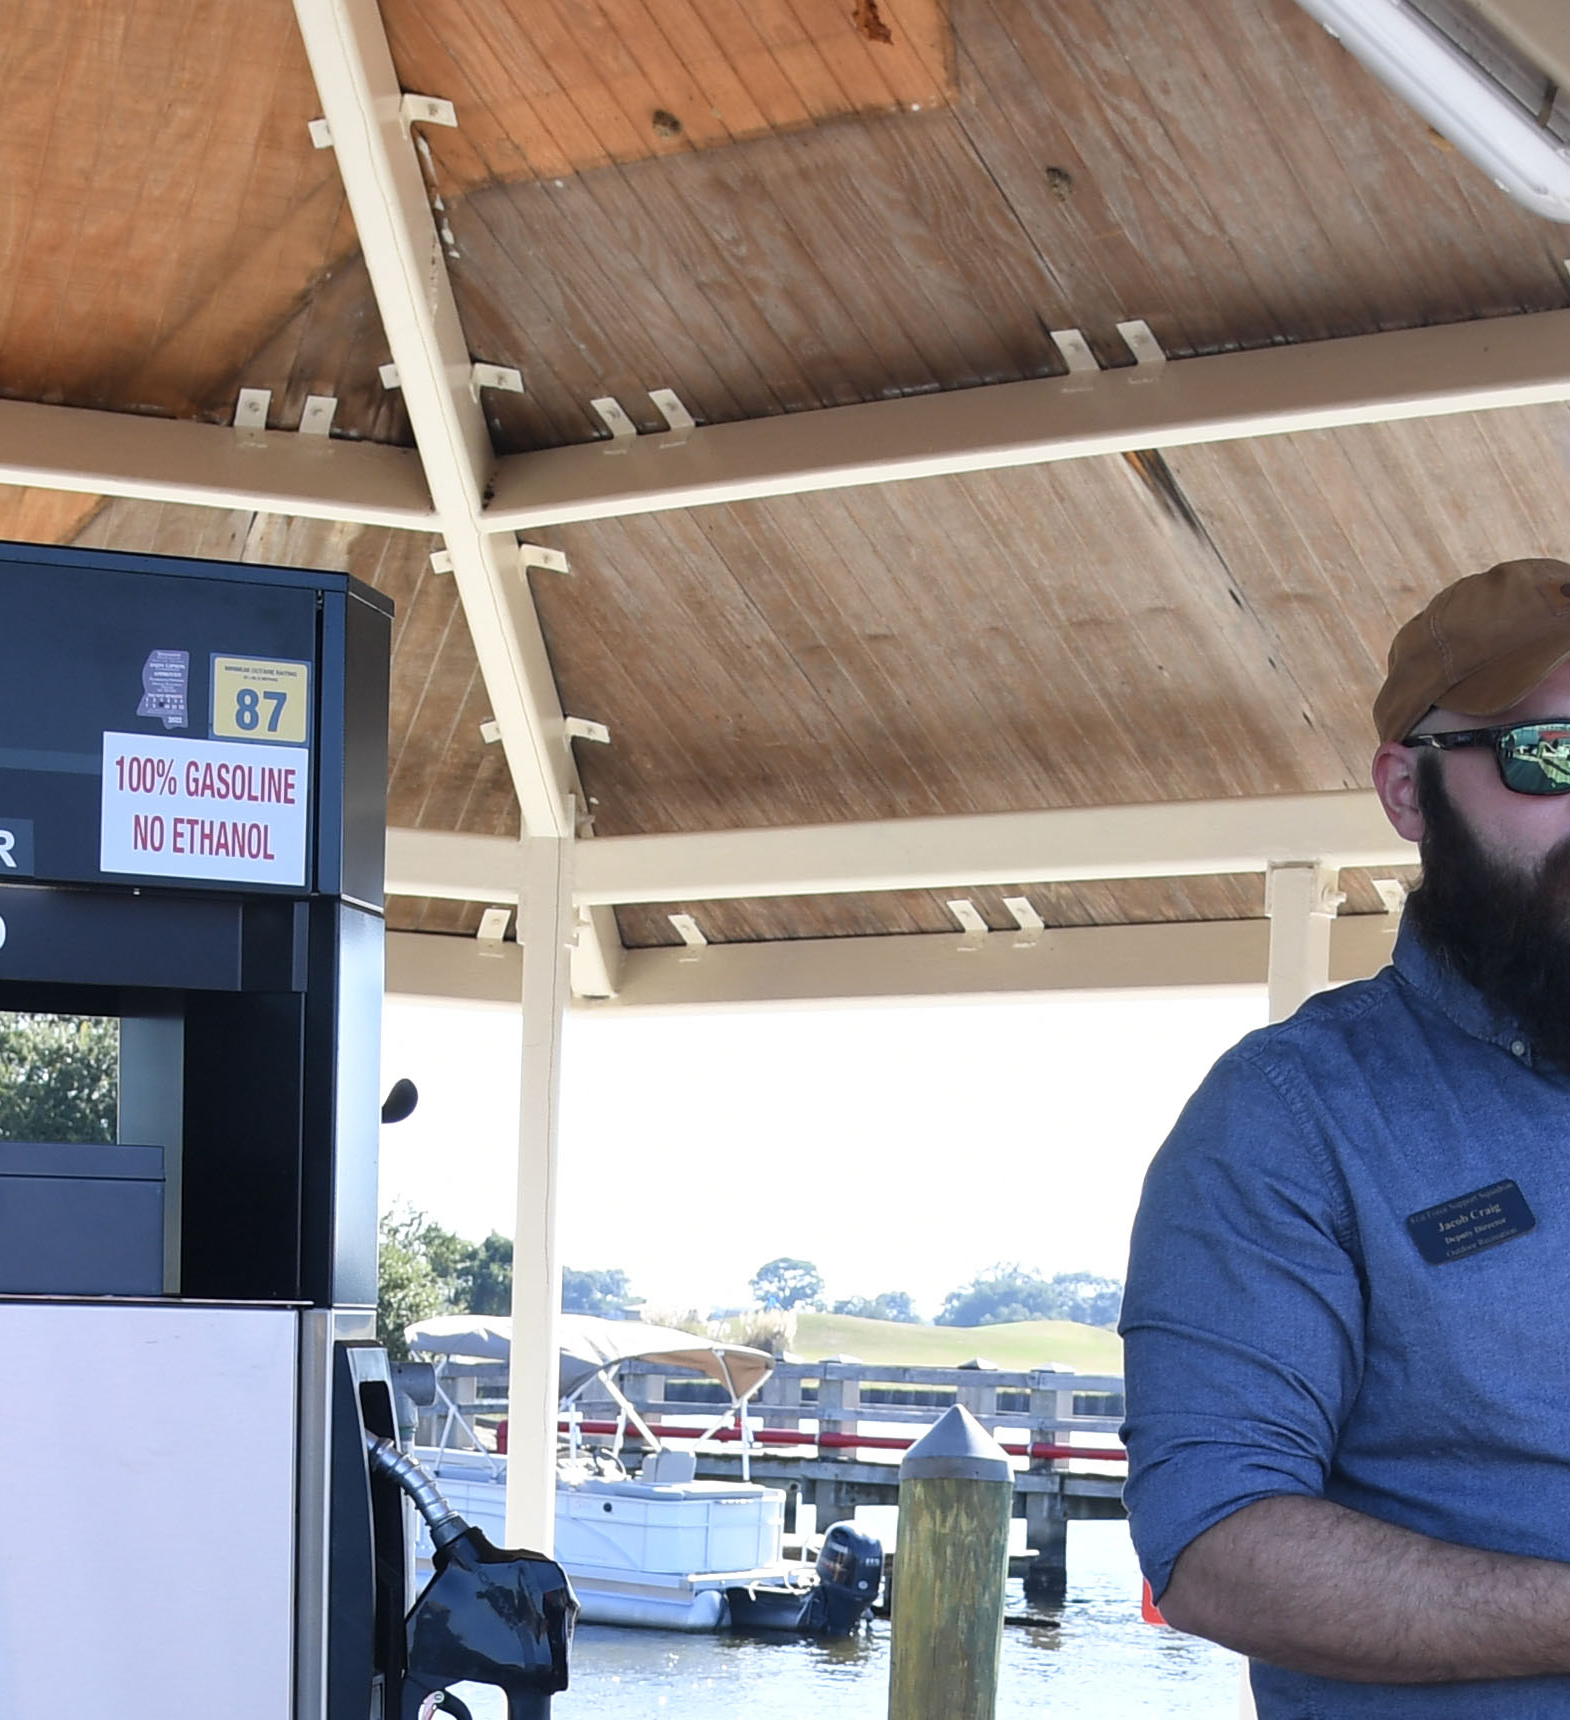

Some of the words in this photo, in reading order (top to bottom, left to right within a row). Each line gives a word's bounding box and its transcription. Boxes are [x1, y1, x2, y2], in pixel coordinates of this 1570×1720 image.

[235, 688, 288, 733] 87
[115, 755, 177, 795] 100%
[185, 760, 297, 805] GASOLINE
[133, 814, 165, 852] NO
[172, 817, 275, 860] ETHANOL
[1438, 1215, 1469, 1233] Jacob
[1470, 1203, 1502, 1221] Craig
[1474, 1217, 1507, 1233] Director
